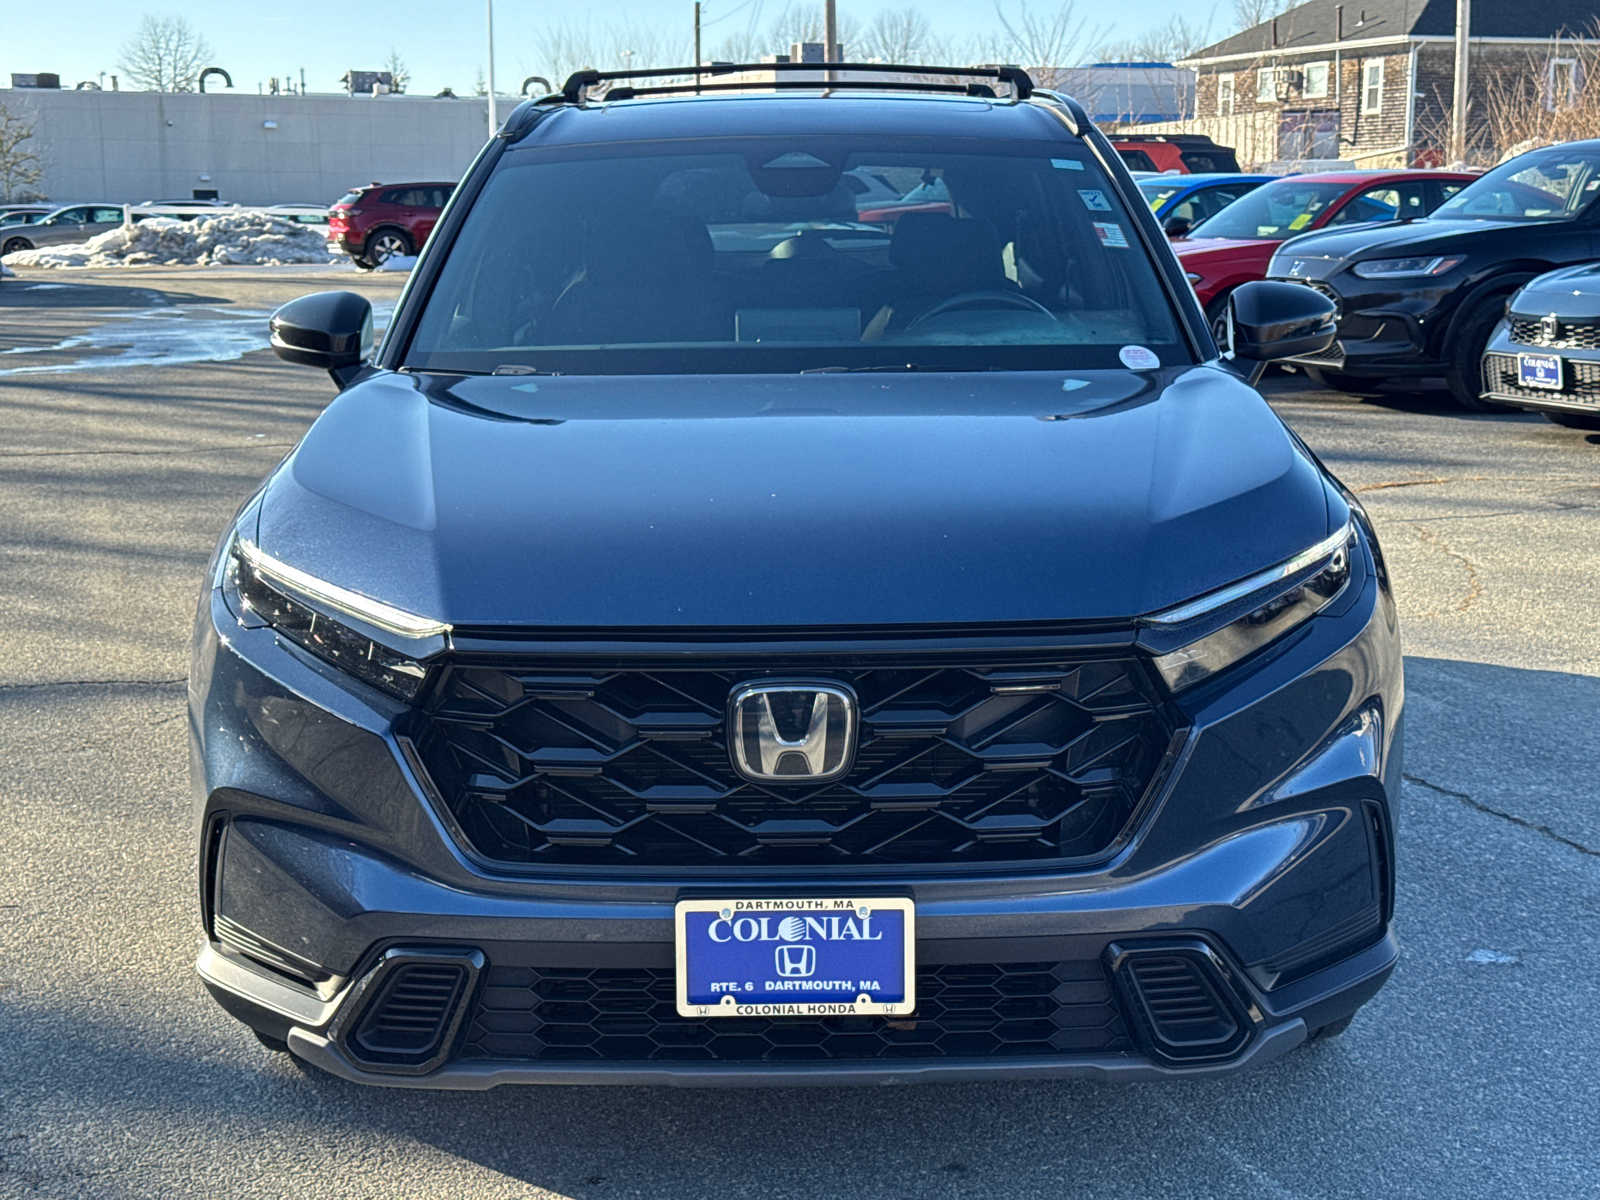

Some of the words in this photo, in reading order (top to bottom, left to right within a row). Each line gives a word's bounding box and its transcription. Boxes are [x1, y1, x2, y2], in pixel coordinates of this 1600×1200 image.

[735, 901, 829, 910] DARTMOUTH,
[833, 900, 854, 909] MA
[708, 916, 882, 943] COLONIAL
[710, 982, 742, 992] RTE.
[744, 981, 754, 992] 6
[765, 980, 856, 992] DARTMOUTH,
[859, 980, 881, 991] MA
[736, 1004, 803, 1015] COLONIAL
[807, 1003, 856, 1014] HONDA
